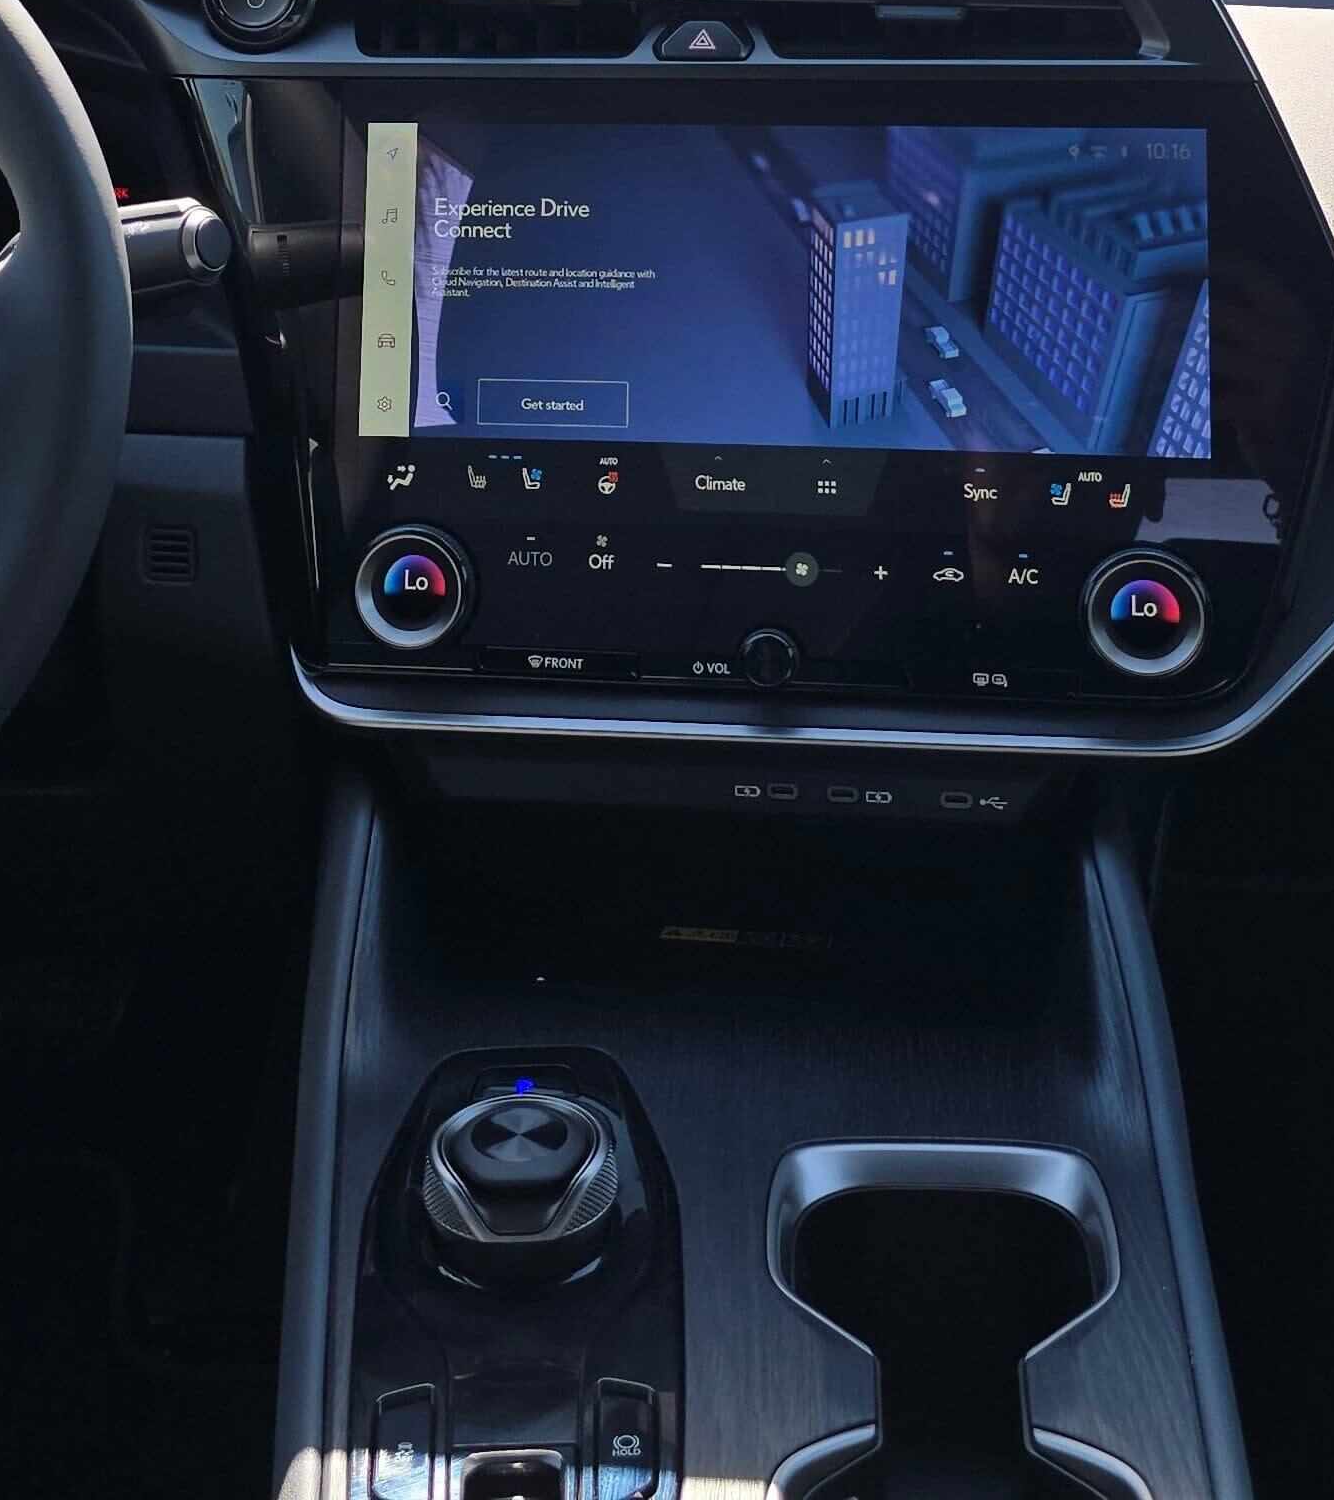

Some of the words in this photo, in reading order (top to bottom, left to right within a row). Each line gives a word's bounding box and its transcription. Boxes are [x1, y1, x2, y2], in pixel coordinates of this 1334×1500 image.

[1146, 142, 1191, 160] 10:16
[434, 198, 535, 220] Experience
[540, 198, 590, 218] Drive
[434, 219, 512, 239] Connect
[473, 267, 485, 276] for
[487, 267, 500, 276] the
[502, 267, 523, 277] latest
[525, 268, 547, 277] route
[549, 268, 565, 277] and
[566, 268, 597, 278] location
[599, 269, 635, 280] guidance
[637, 269, 656, 279] with
[458, 277, 504, 288] Navigation,
[506, 278, 552, 288] Destination
[553, 279, 577, 288] Assist
[578, 279, 594, 288] and
[595, 279, 635, 291] Intelligent
[521, 398, 543, 411] Get
[545, 400, 584, 411] started
[599, 457, 619, 466] AUTO
[695, 474, 746, 492] Climate
[1077, 471, 1102, 483] AUTO
[964, 484, 998, 502] Sync
[508, 550, 553, 566] AUTO
[588, 553, 615, 571] Off
[404, 569, 428, 591] Lo
[1008, 569, 1039, 585] A/C
[1131, 596, 1157, 617] Lo
[545, 657, 584, 670] FRONT
[707, 662, 731, 675] VOL
[612, 1449, 641, 1457] HOLD
